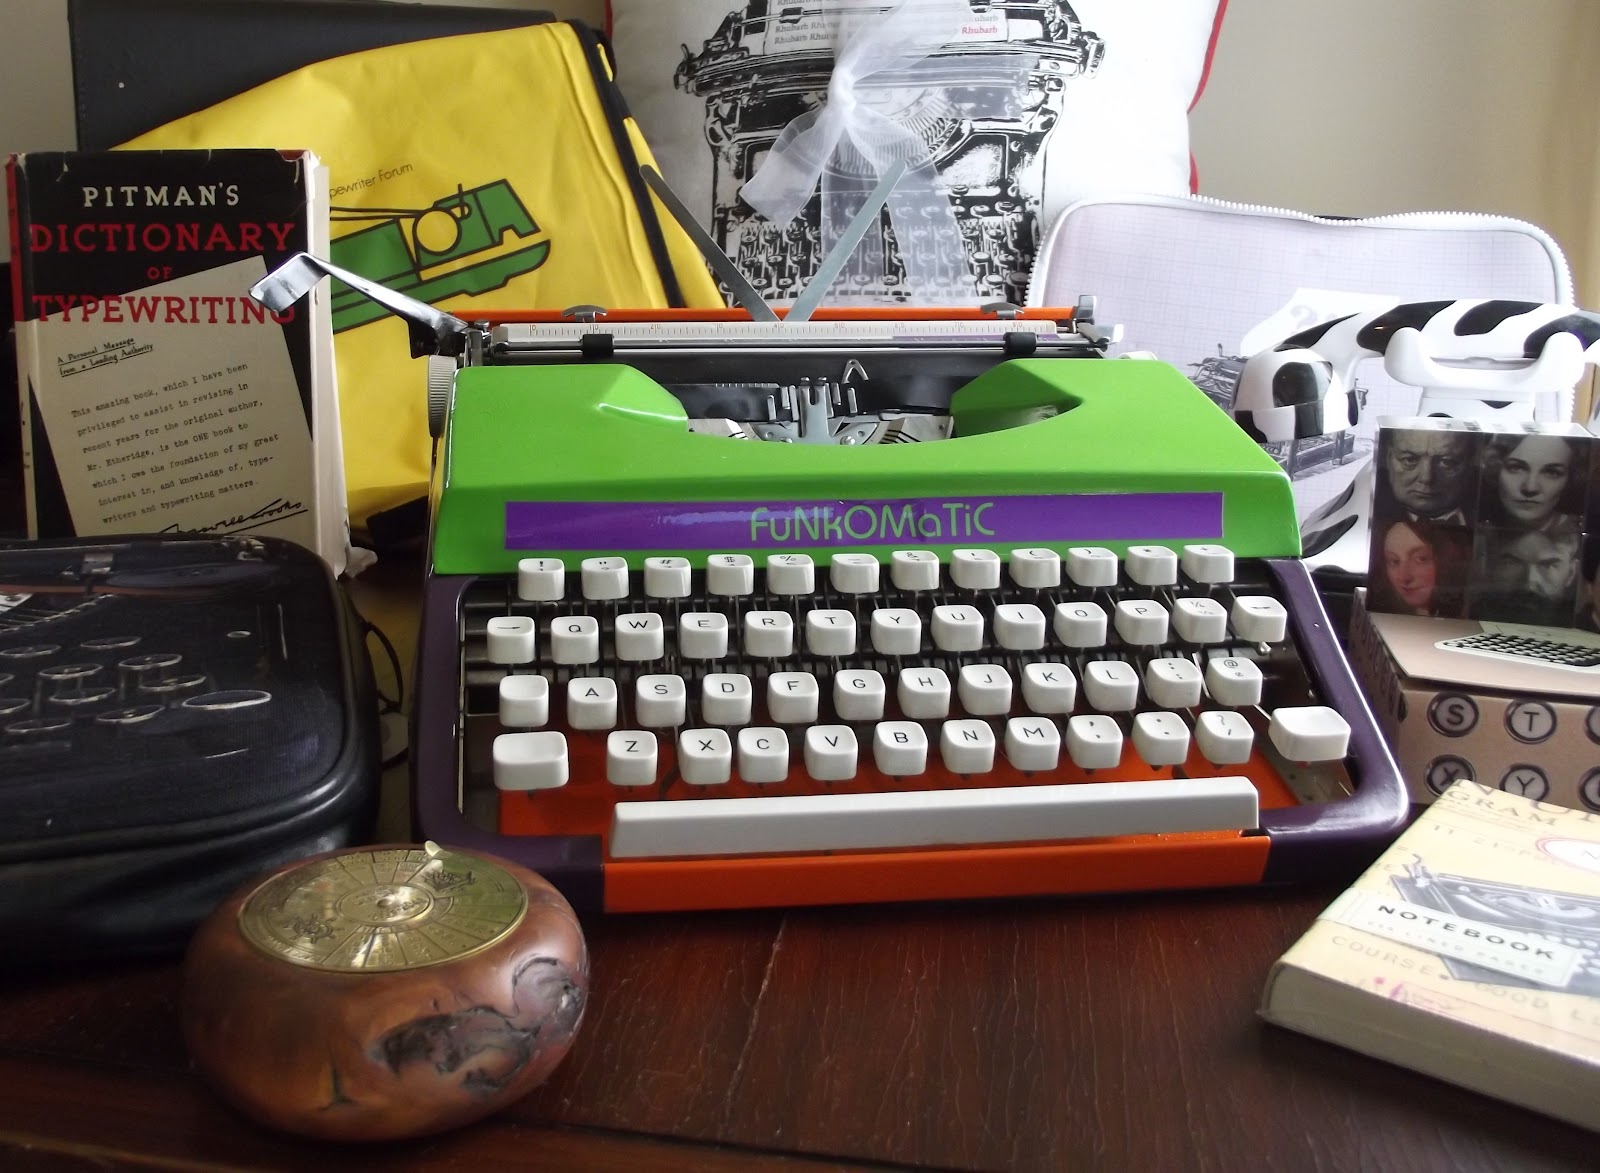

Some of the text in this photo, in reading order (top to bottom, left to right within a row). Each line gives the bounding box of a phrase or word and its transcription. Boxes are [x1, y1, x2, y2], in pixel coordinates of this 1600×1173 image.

[962, 26, 998, 35] Rhubarb
[378, 163, 413, 181] Forum
[82, 182, 240, 208] PITMAN'S
[30, 223, 295, 252] DICTIONARY
[146, 266, 174, 280] OF
[71, 408, 91, 418] This
[133, 389, 158, 400] book,
[162, 380, 189, 392] which
[192, 376, 198, 384] I
[201, 371, 223, 382] have
[226, 363, 248, 374] been
[77, 382, 249, 437] privileged to assist in revising in
[82, 400, 263, 454] recent years for the original author,
[159, 444, 170, 452] is
[173, 438, 189, 448] the
[192, 432, 210, 443] ONE
[212, 426, 234, 437] book
[238, 423, 249, 431] to
[92, 477, 118, 489] which
[131, 470, 146, 479] owe
[150, 464, 165, 474] the
[169, 450, 219, 469] foundation
[223, 444, 234, 454] of
[237, 442, 249, 451] my
[253, 433, 279, 448] great
[98, 456, 274, 507] interest in, and knowledge of, type-
[102, 510, 137, 524] writers
[141, 504, 156, 515] and
[160, 490, 215, 510] typewriting
[568, 624, 583, 634] Q
[628, 619, 649, 629] W
[697, 619, 710, 628] E
[762, 617, 776, 626] R
[824, 616, 836, 625] T
[889, 615, 902, 624] Y
[951, 612, 965, 621] U
[1074, 609, 1088, 617] O
[1134, 607, 1148, 615] P
[584, 687, 600, 697] A
[654, 684, 669, 695] S
[721, 682, 735, 693] D
[787, 680, 799, 691] F
[852, 678, 866, 689] G
[918, 676, 934, 687] H
[983, 673, 993, 684] J
[1041, 671, 1059, 682] K
[1105, 669, 1119, 680] L
[1446, 703, 1540, 732] S T
[625, 740, 639, 752] Z
[698, 739, 715, 751] X
[756, 739, 770, 750] C
[824, 735, 839, 747] V
[893, 732, 909, 743] B
[962, 729, 979, 741] N
[1023, 727, 1044, 738] M
[1515, 775, 1536, 796] Y
[1378, 904, 1554, 960] NOTEBOOK
